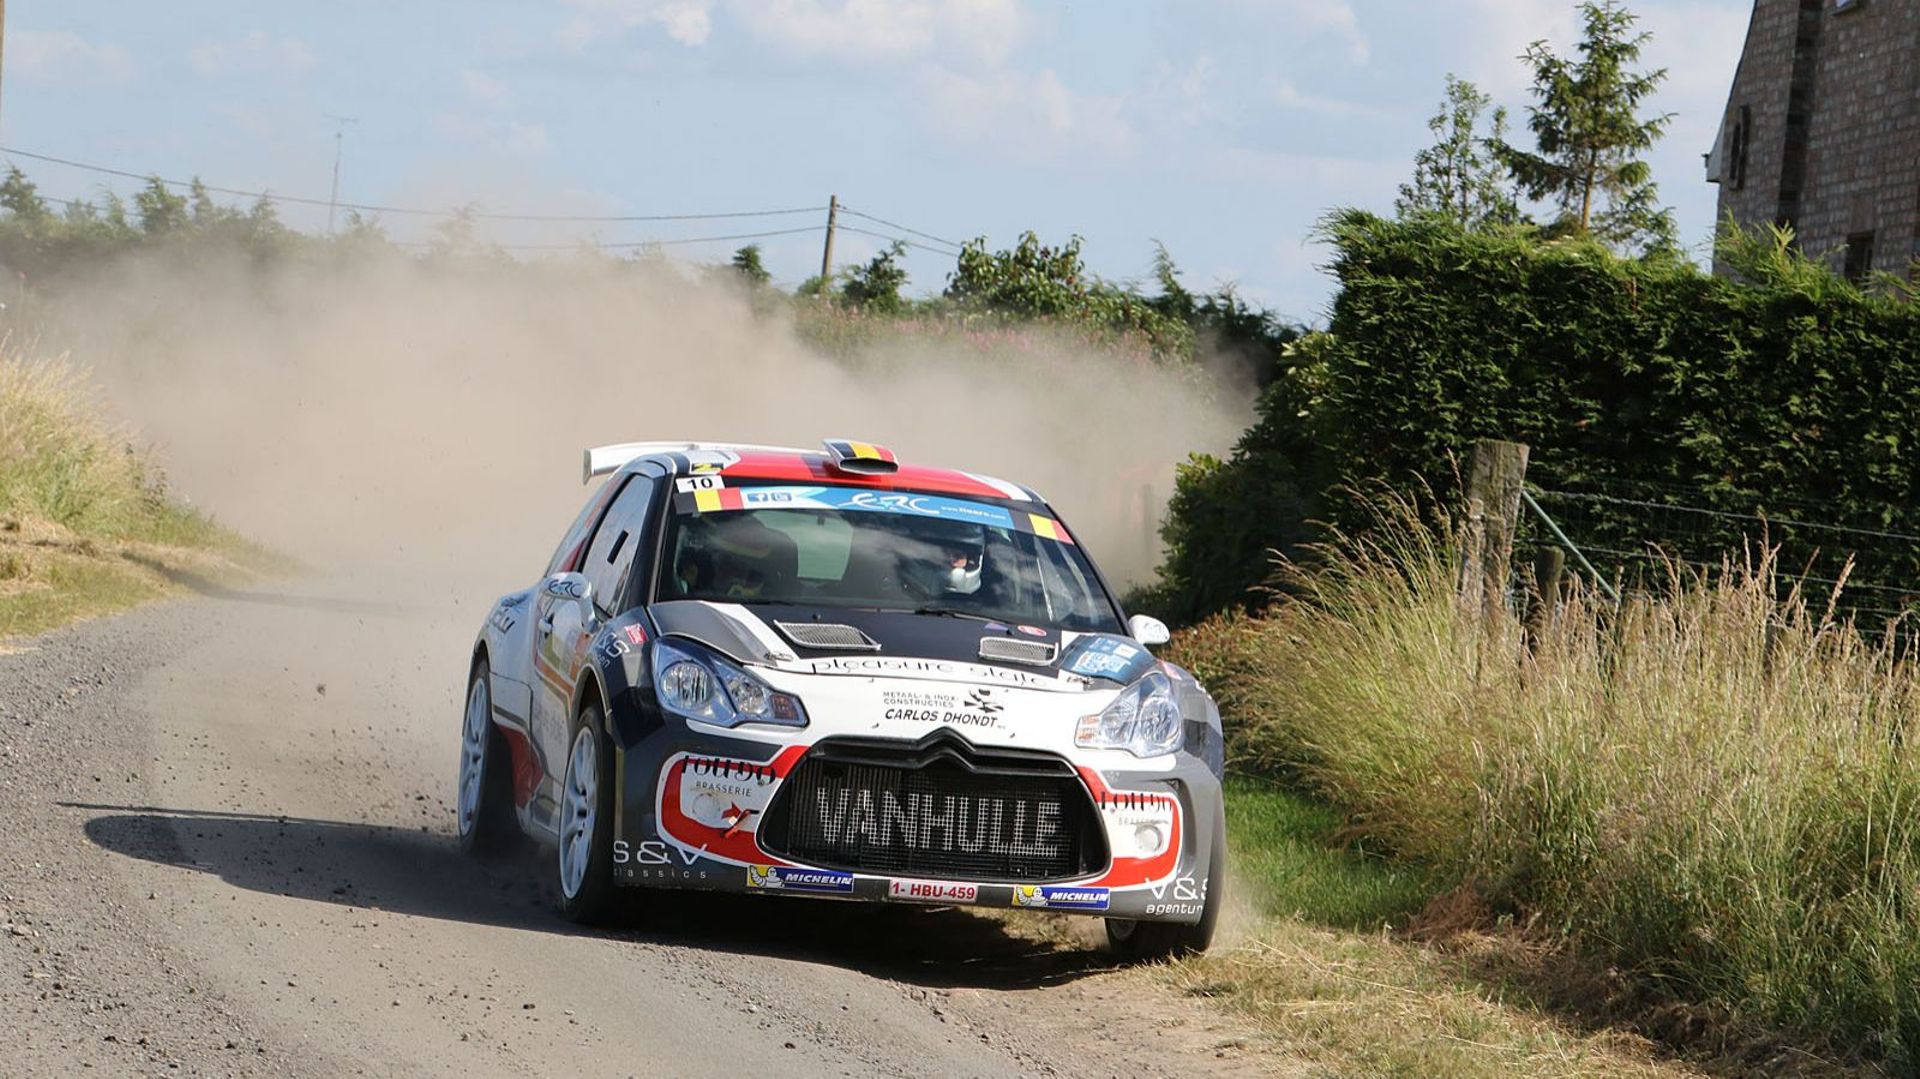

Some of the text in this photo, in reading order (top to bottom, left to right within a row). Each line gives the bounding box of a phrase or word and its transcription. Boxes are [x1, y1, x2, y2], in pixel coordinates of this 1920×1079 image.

[688, 477, 713, 489] 10
[883, 698, 955, 708] CONSTRUCTIES
[885, 708, 939, 722] CARLOS
[943, 712, 998, 727] DHONDT
[696, 780, 752, 797] BRASSERIE
[817, 787, 1061, 857] VANHULLE
[785, 873, 851, 885] MICHELIN
[1049, 891, 1109, 903] MICHELIN
